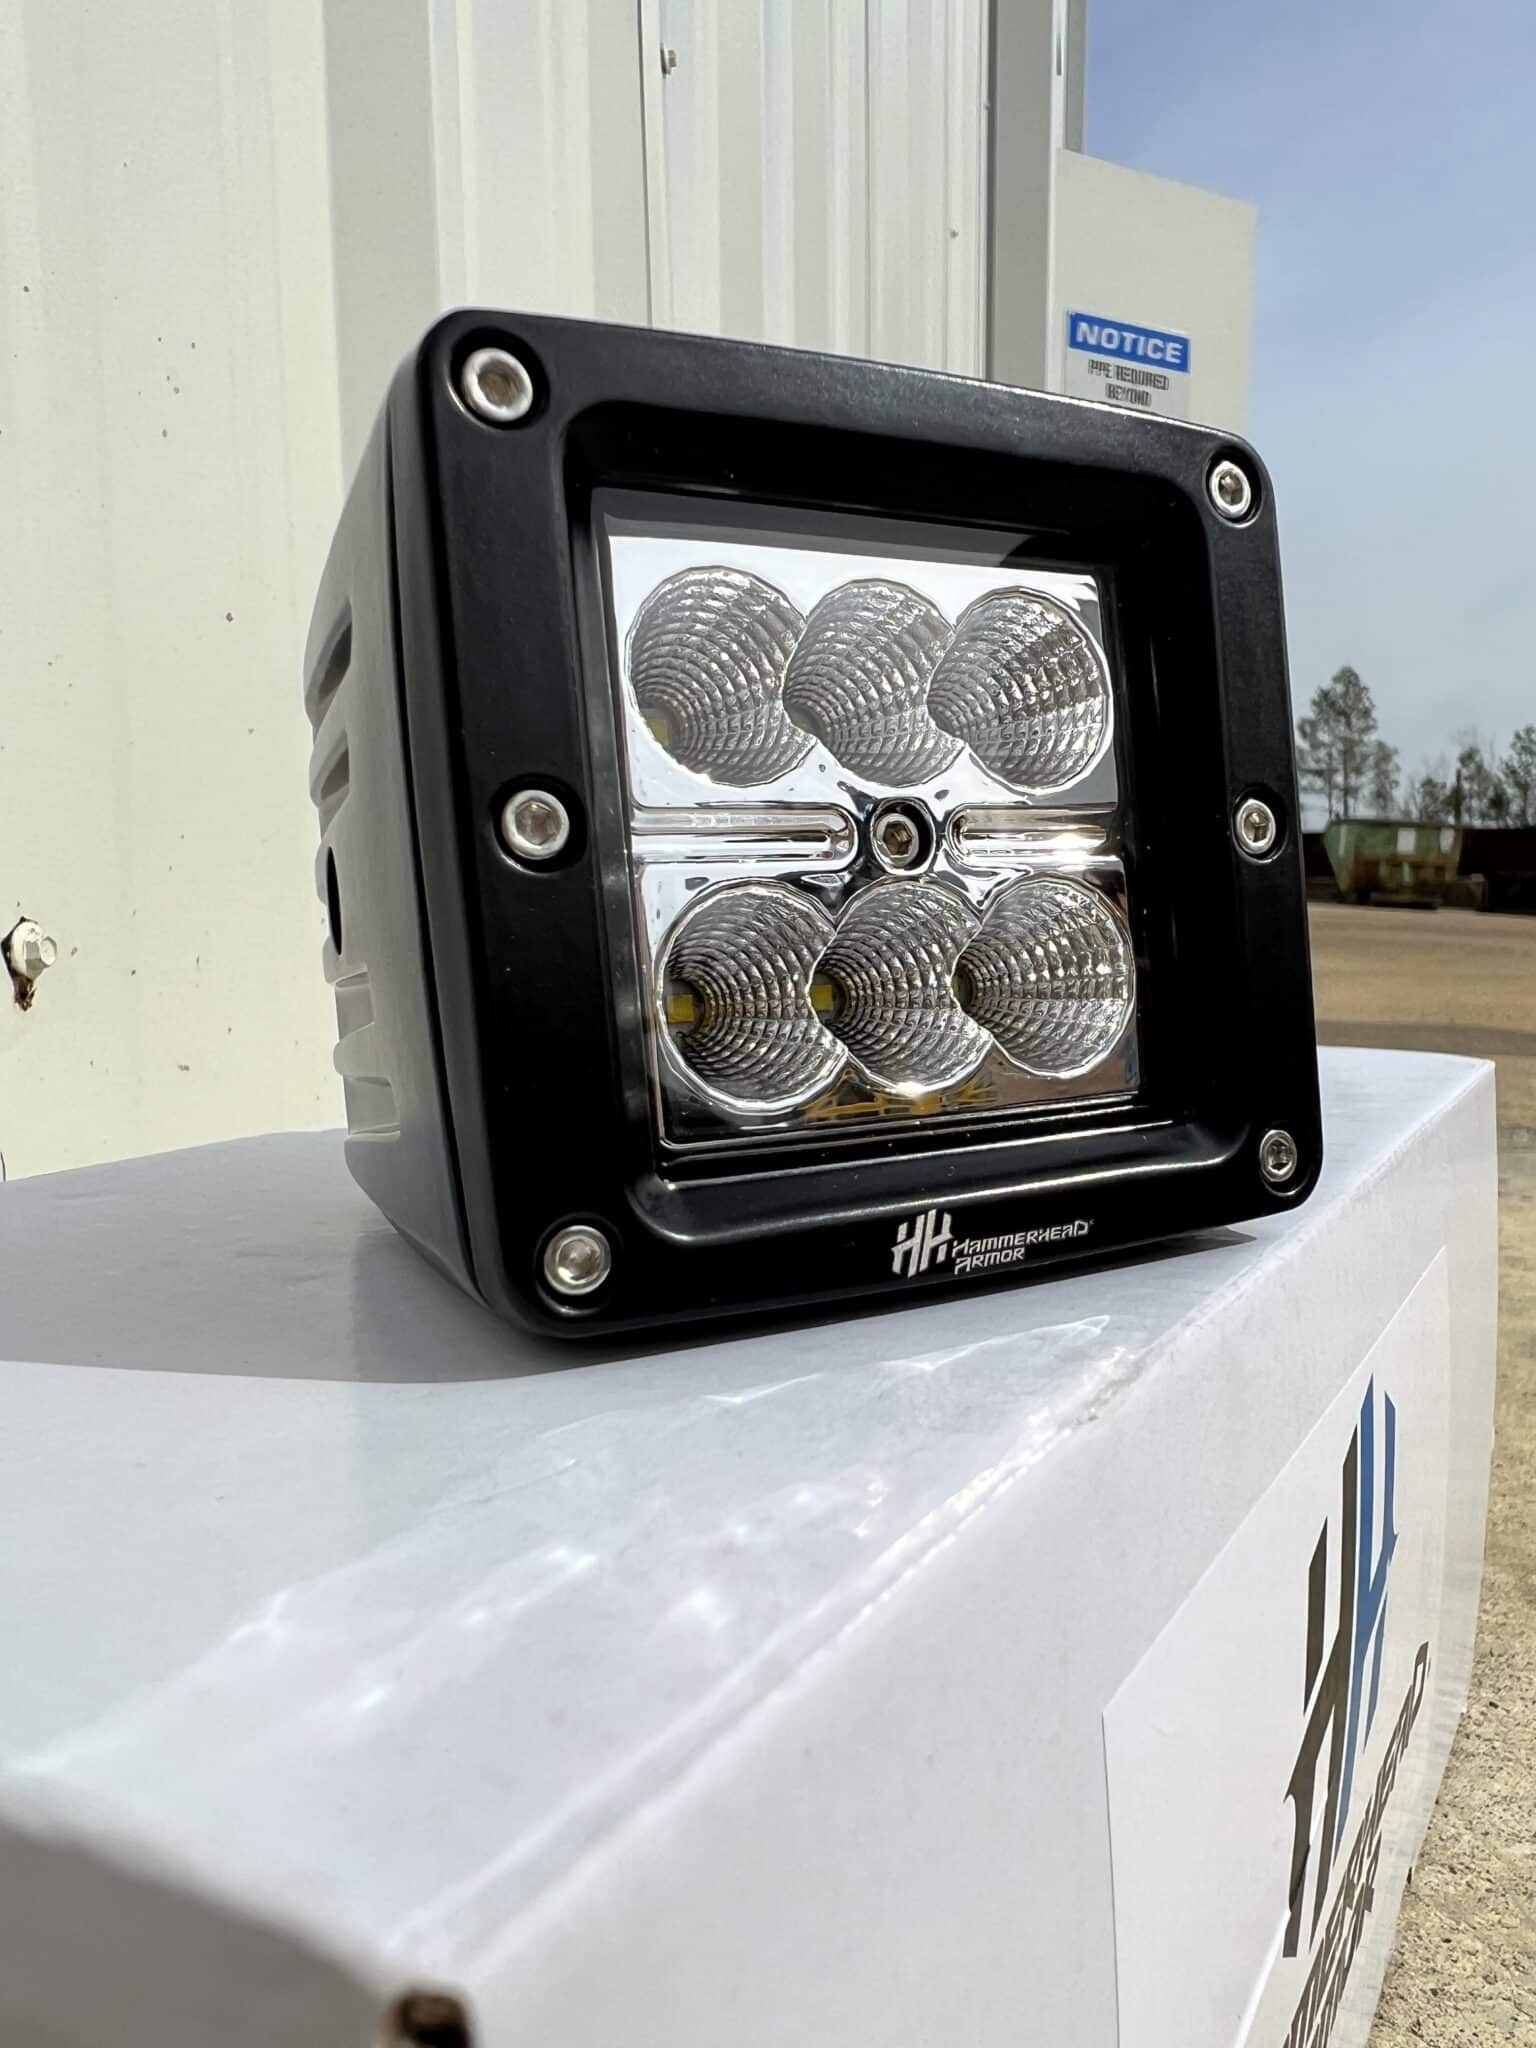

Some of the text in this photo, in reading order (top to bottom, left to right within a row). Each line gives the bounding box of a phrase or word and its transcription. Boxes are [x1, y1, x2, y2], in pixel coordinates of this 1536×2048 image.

[1076, 321, 1183, 364] NOTICE
[952, 1219, 1089, 1258] HAMMERHEAD
[954, 1247, 1025, 1275] ARMOR
